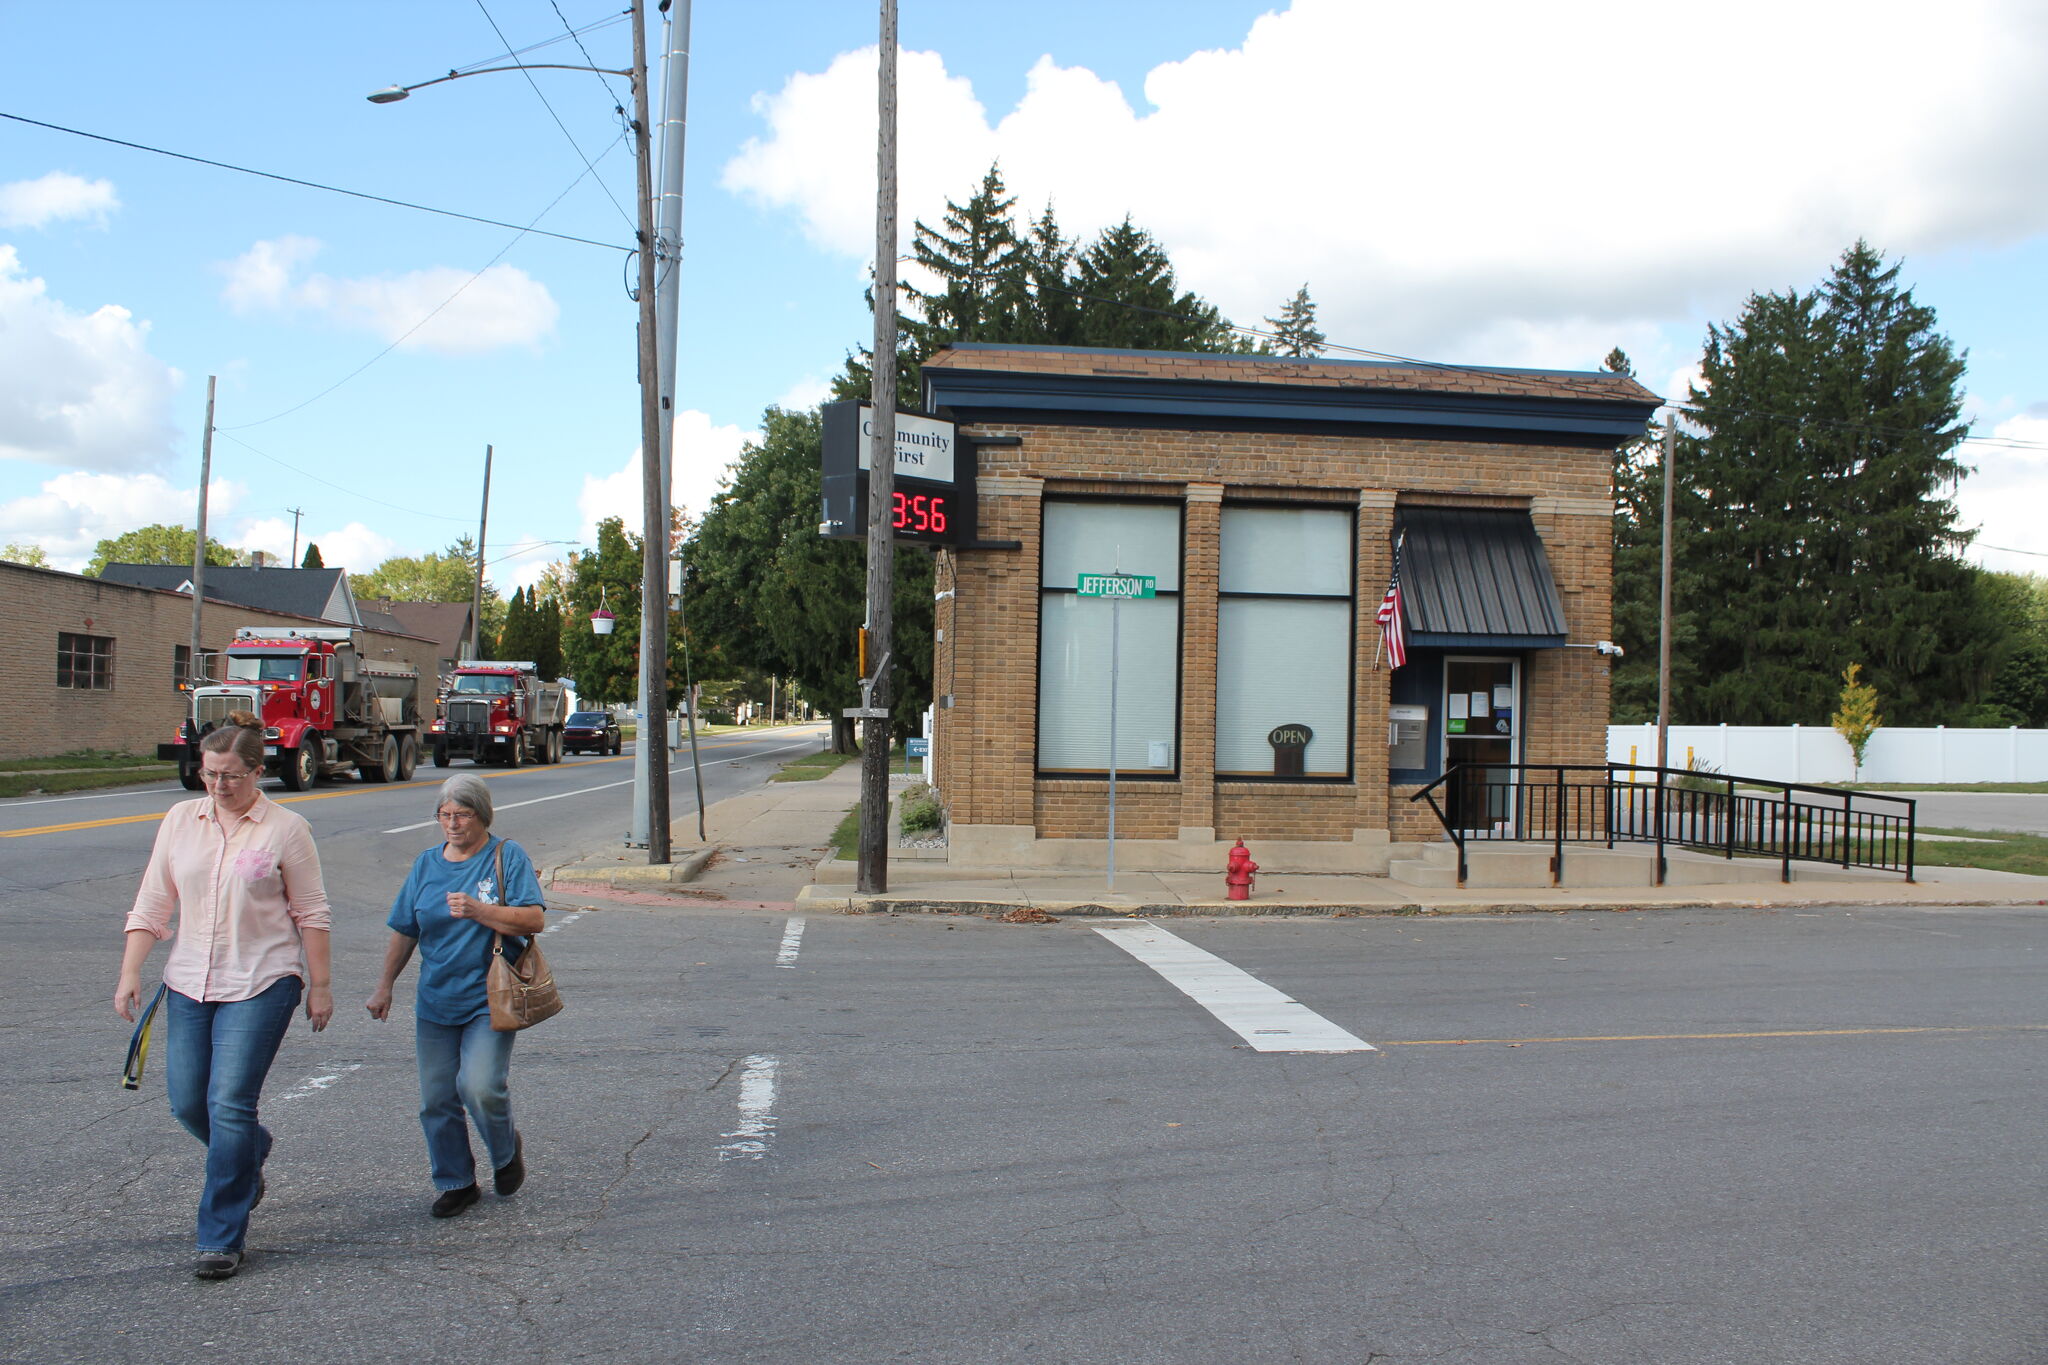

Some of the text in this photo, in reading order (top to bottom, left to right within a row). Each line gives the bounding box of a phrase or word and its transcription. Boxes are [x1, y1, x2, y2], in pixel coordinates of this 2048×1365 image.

[863, 421, 950, 453] Cmunity
[892, 492, 946, 533] 3:56
[1079, 576, 1154, 595] JEFFERSON RD
[1272, 729, 1306, 744] OPEN
